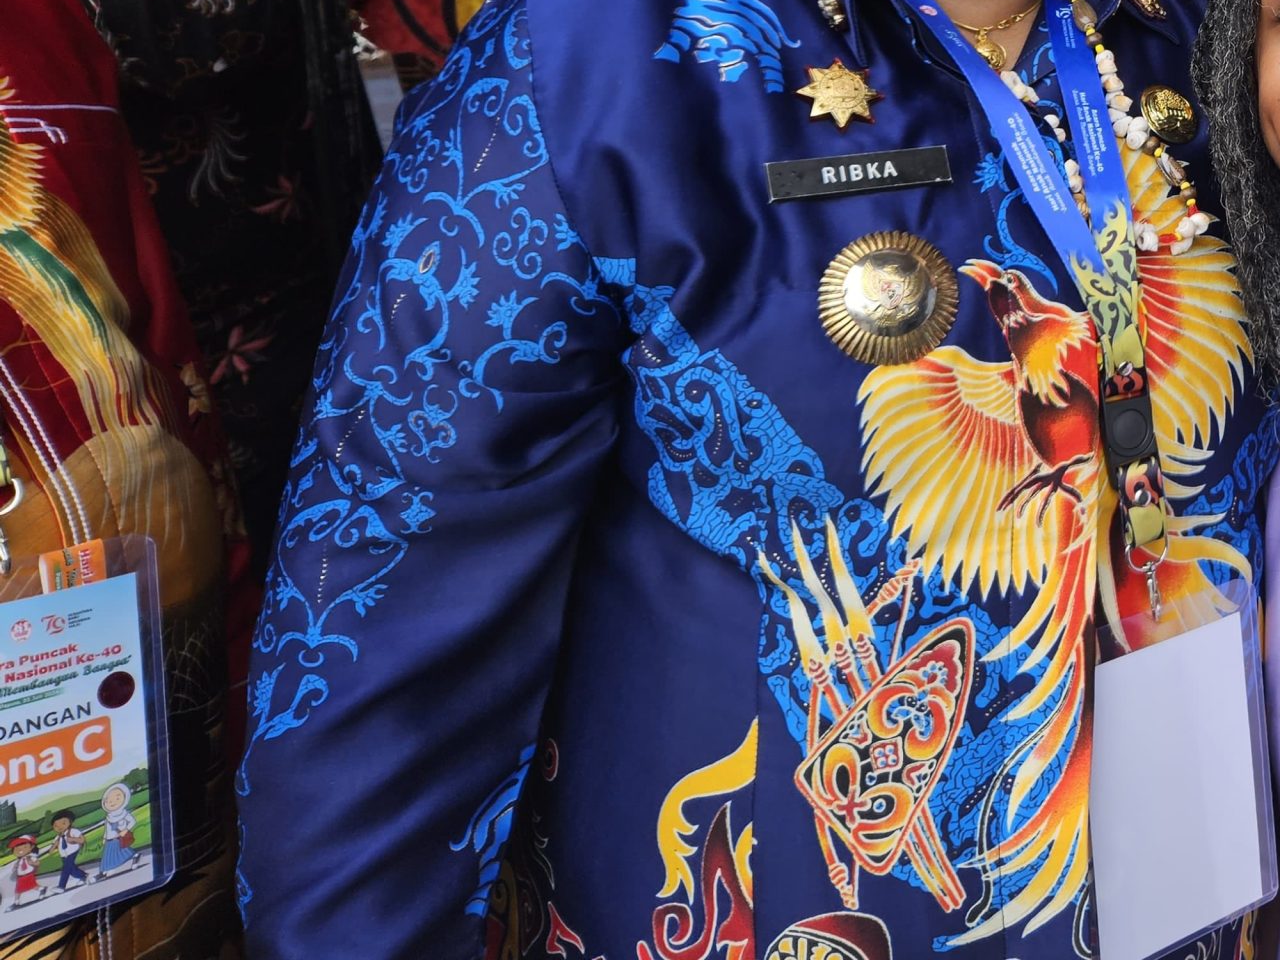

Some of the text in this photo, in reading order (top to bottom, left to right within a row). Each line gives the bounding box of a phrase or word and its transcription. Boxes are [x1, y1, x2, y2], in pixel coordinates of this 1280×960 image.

[821, 160, 898, 185] RIBKA
[4, 644, 122, 683] Nasional Ke-40
[19, 643, 78, 666] Puncak
[0, 725, 106, 786] na C
